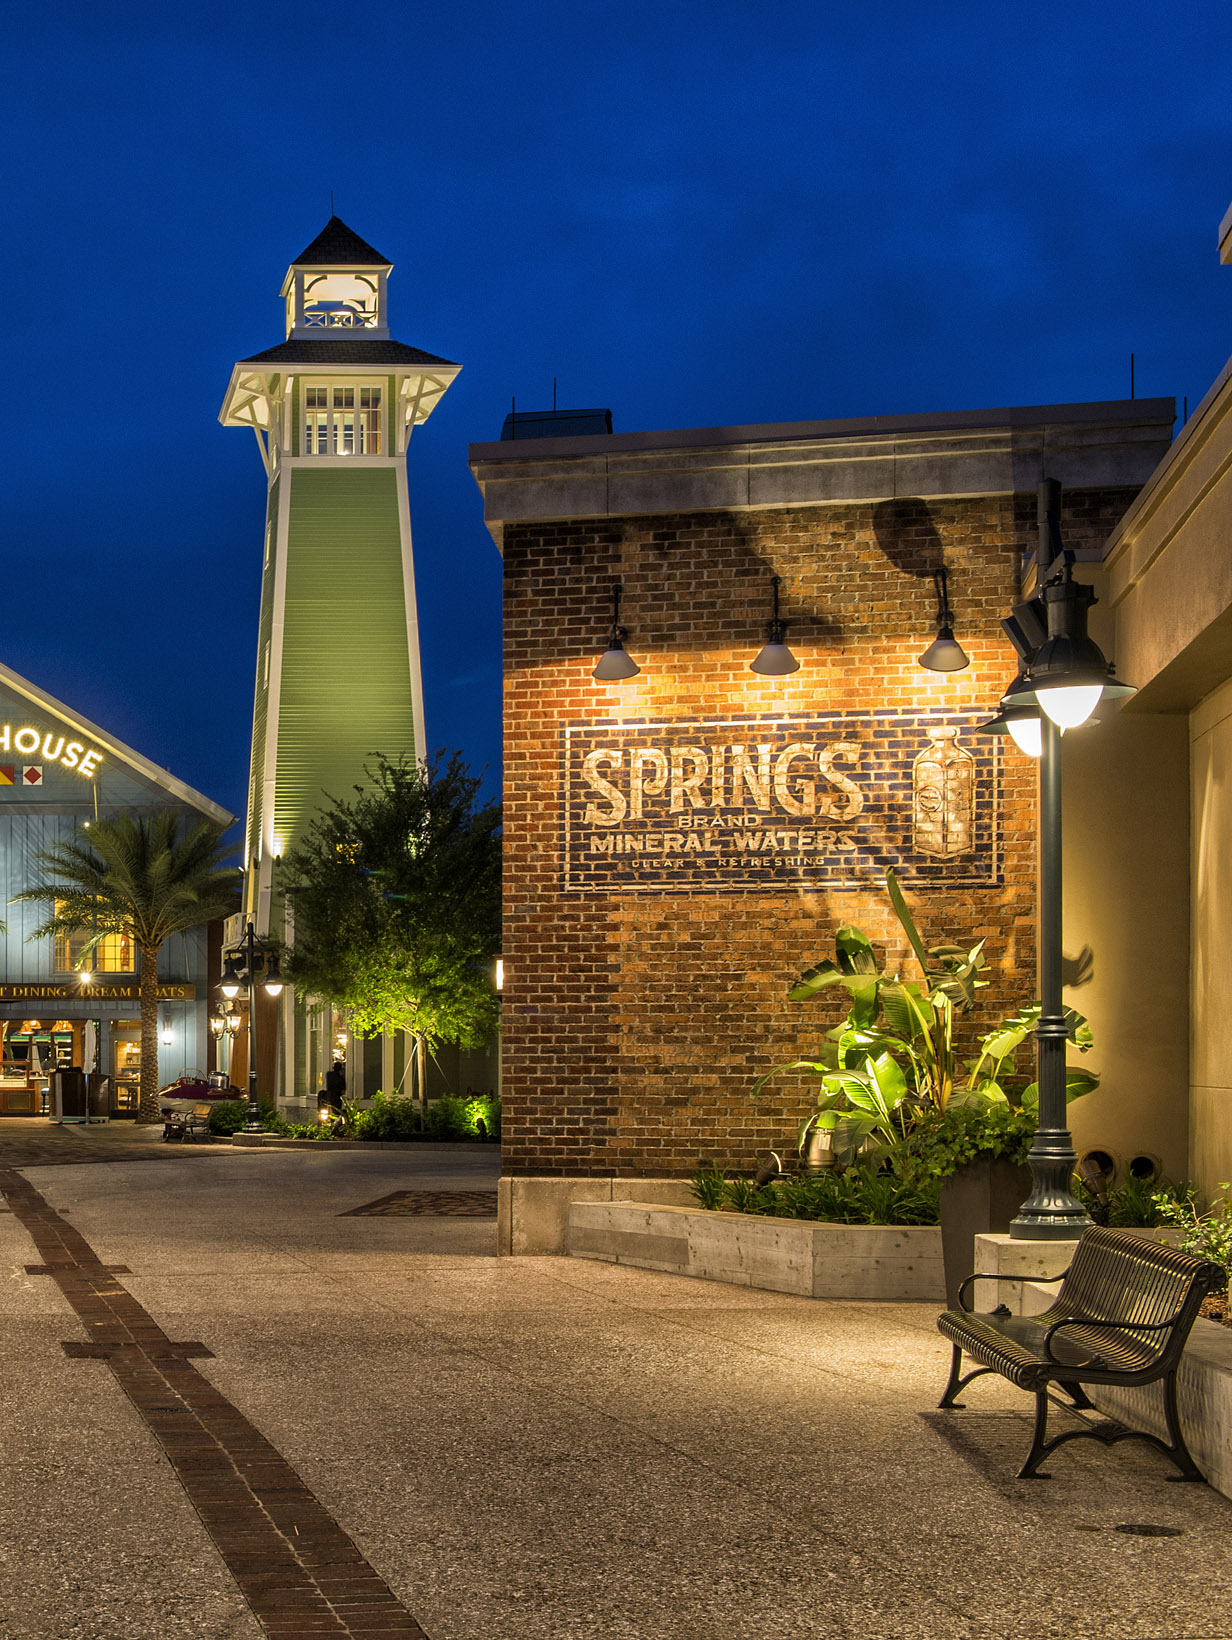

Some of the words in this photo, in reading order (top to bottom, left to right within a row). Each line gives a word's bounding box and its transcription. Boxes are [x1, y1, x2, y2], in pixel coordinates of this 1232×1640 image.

[583, 742, 864, 827] SPRINGS
[678, 814, 761, 829] BRAND
[590, 832, 722, 854] MINERAL
[733, 830, 856, 852] WATERS
[631, 859, 685, 868] CLEAR
[717, 856, 826, 867] REFRESHING
[12, 986, 68, 997] DINING
[80, 986, 131, 997] DREAM
